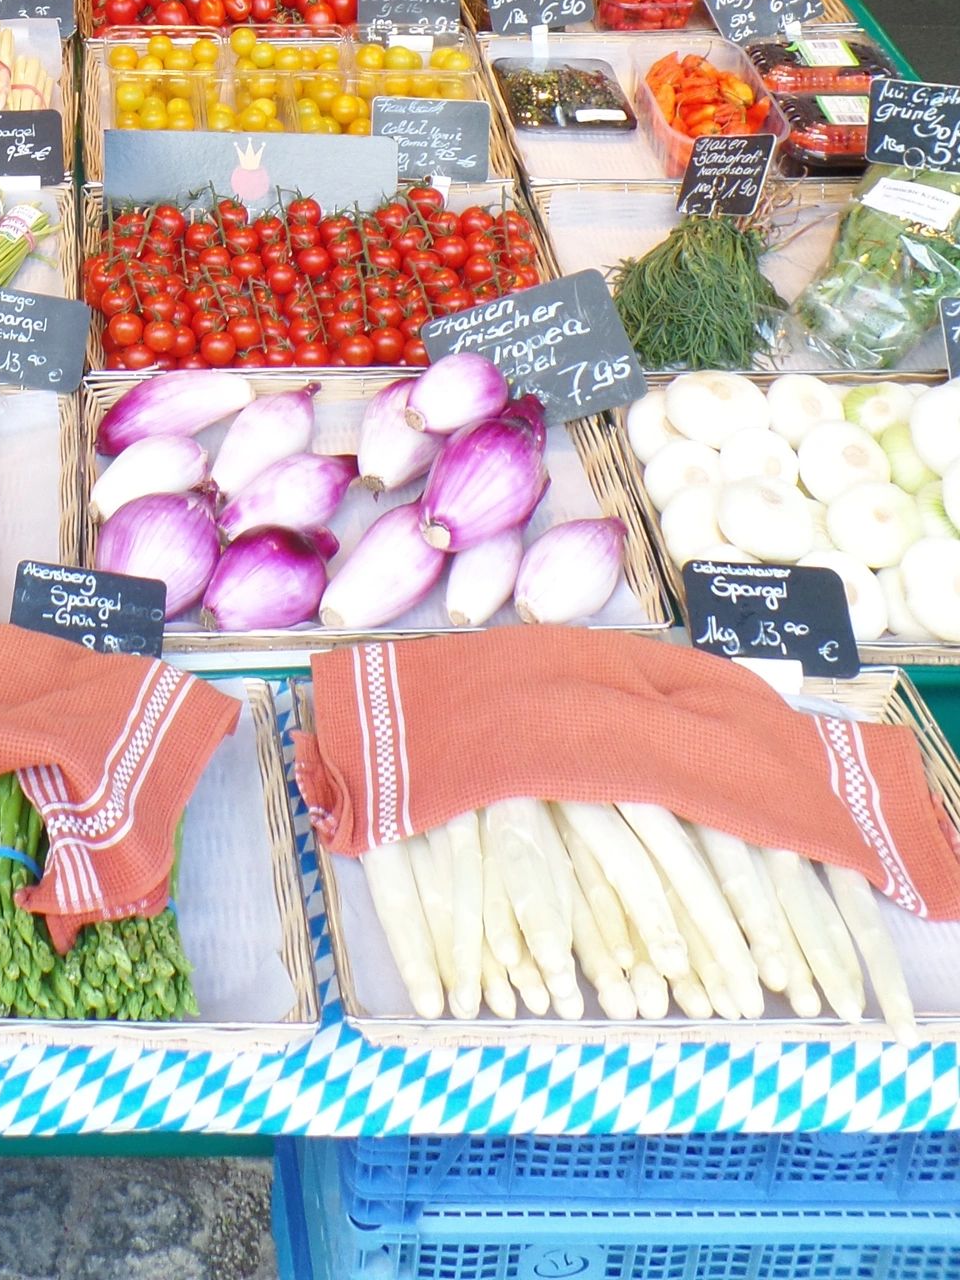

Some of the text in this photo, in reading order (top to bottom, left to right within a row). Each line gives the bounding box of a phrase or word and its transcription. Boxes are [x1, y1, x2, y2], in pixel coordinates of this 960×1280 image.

[428, 299, 517, 340] Italien
[557, 355, 632, 406] 7.95
[23, 566, 98, 596] Abensberg
[710, 575, 788, 610] Spargel
[50, 582, 123, 620] Spargel
[696, 615, 740, 657] 1kg
[817, 640, 840, 664] €
